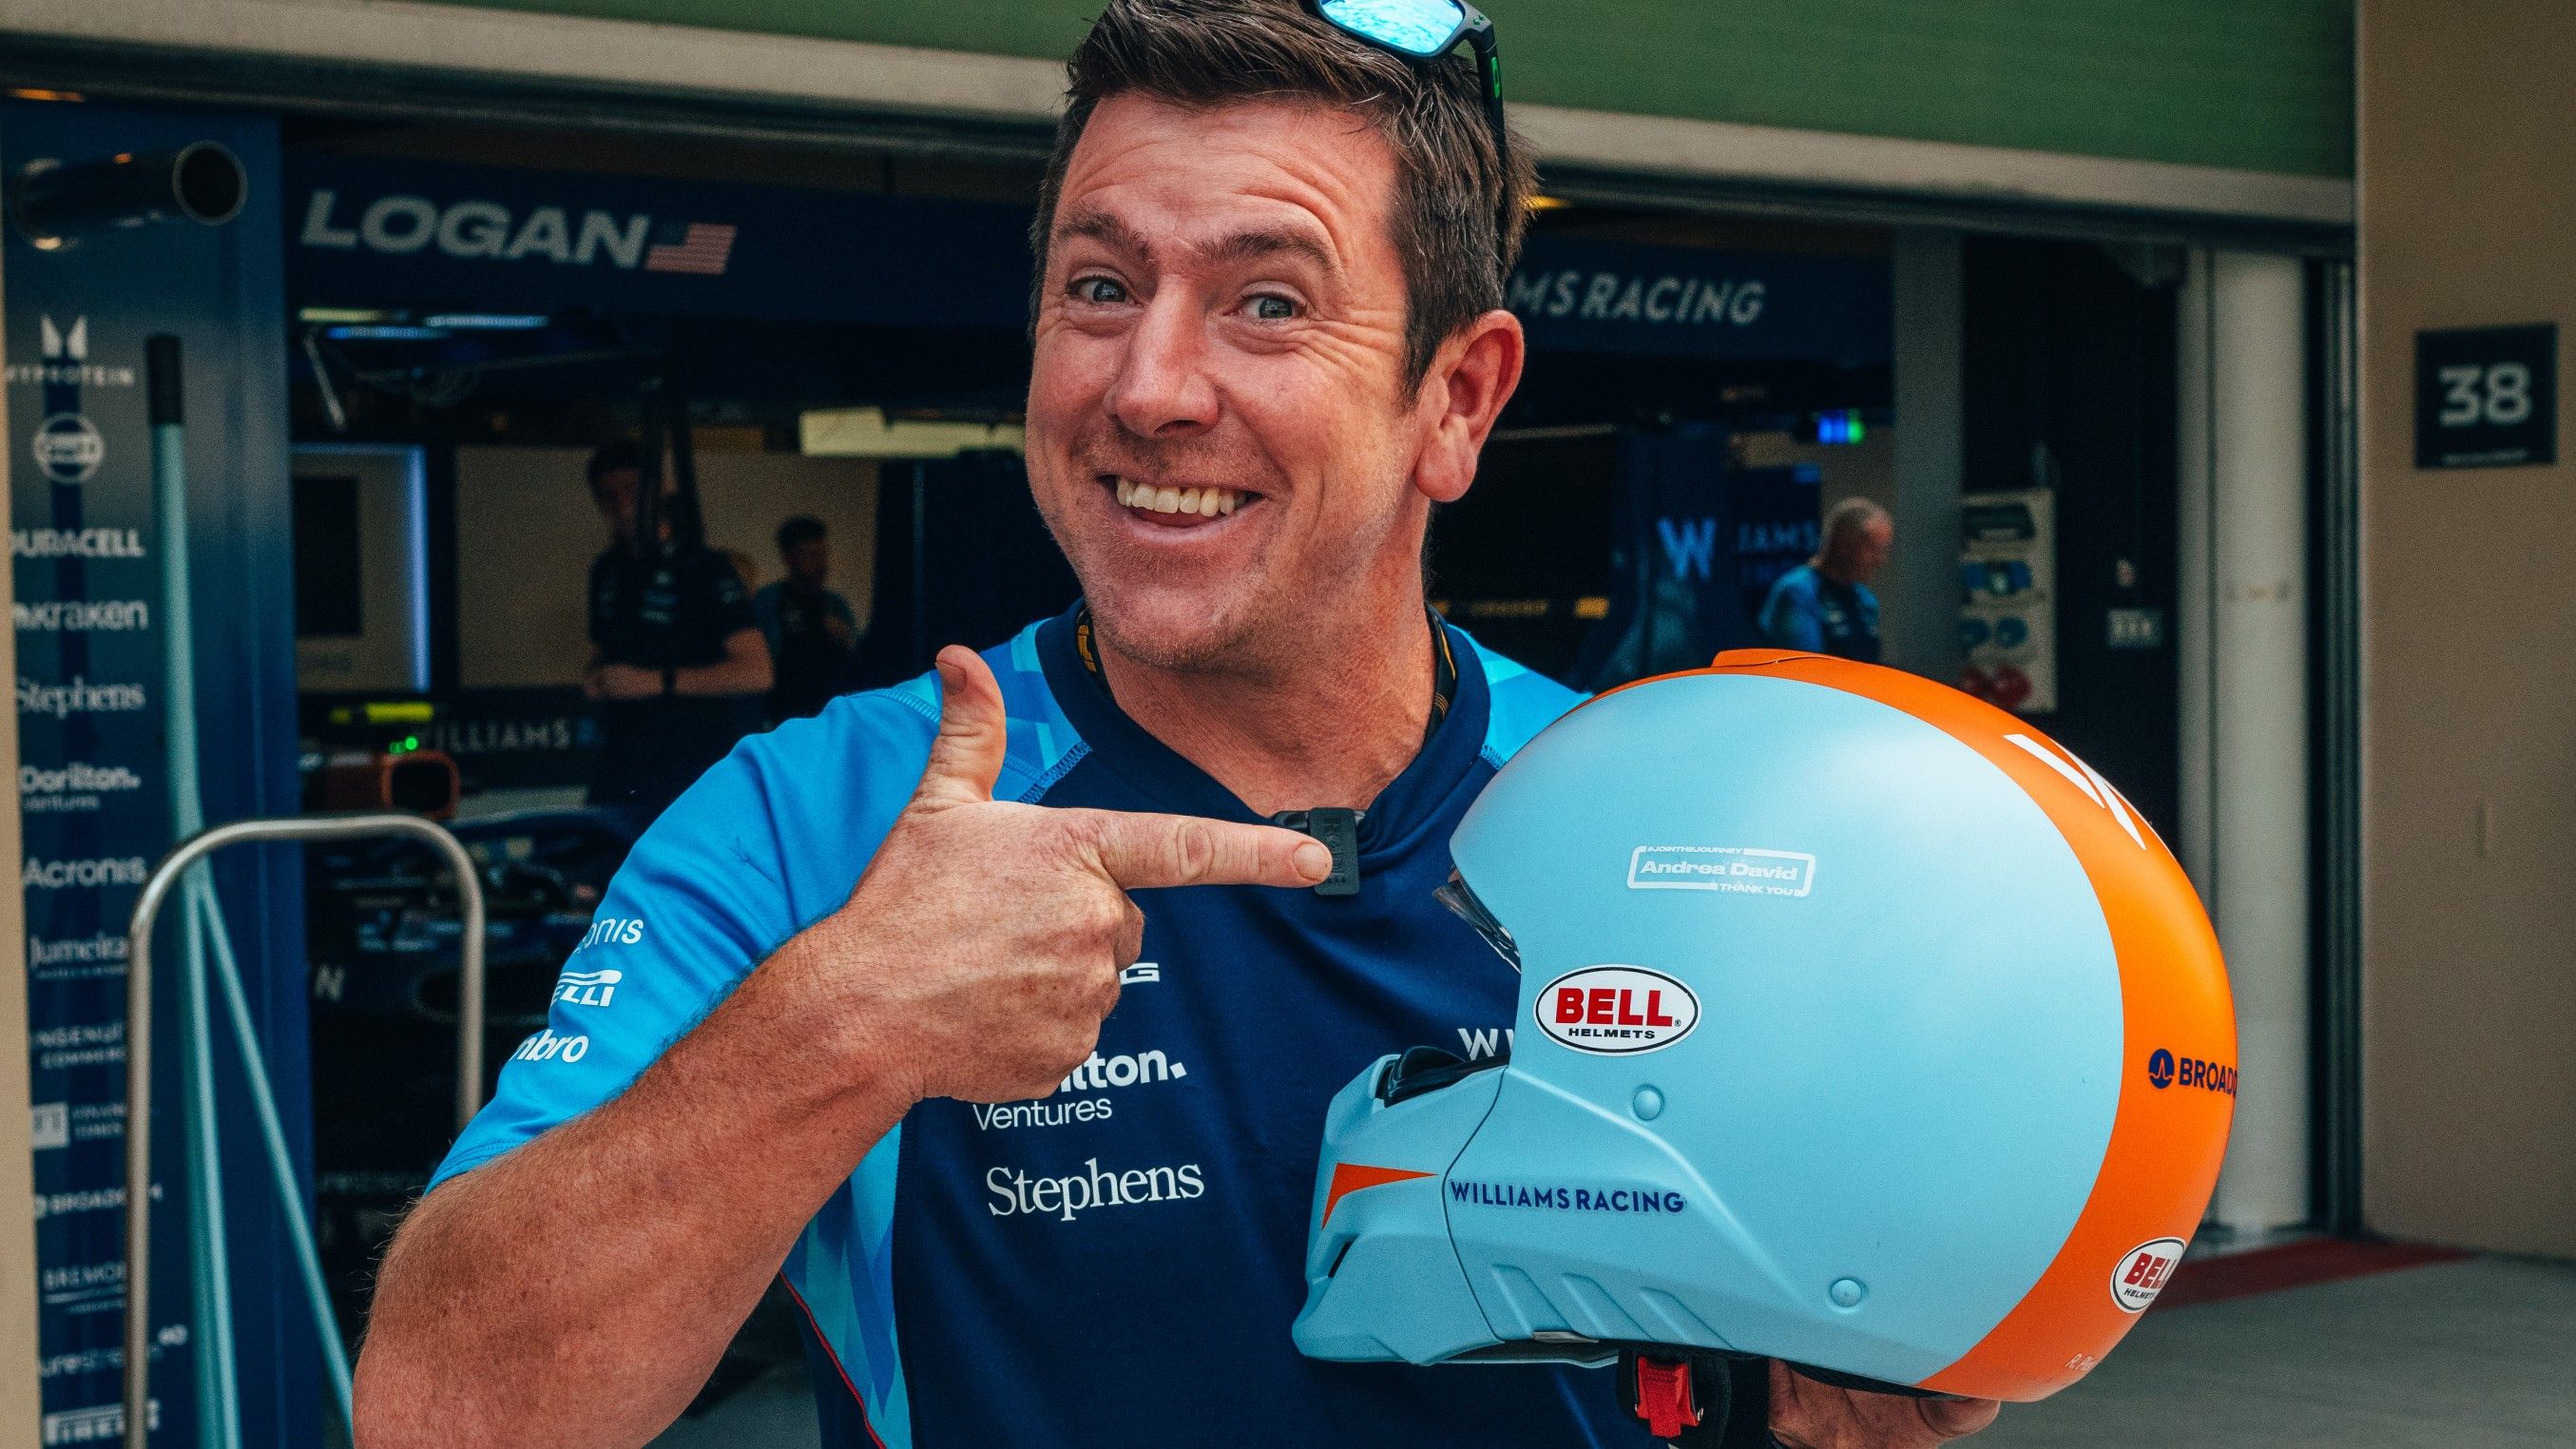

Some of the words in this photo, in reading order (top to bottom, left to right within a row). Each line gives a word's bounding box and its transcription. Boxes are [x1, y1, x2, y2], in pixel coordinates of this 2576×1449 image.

[301, 189, 651, 270] LOGAN
[1581, 271, 1766, 325] RACING
[2439, 362, 2532, 427] 38
[1641, 860, 1726, 876] Andrea
[1730, 862, 1798, 881] David
[1720, 882, 1764, 894] THANK
[1765, 885, 1794, 897] YOU
[29, 931, 129, 970] Jumeira
[574, 918, 644, 955] onis
[1568, 1028, 1656, 1039] HELMETS
[972, 1098, 1113, 1131] Ventures
[986, 1157, 1205, 1223] Stephens
[1451, 1181, 1569, 1209] WILLIAMS
[1575, 1188, 1685, 1213] RACING
